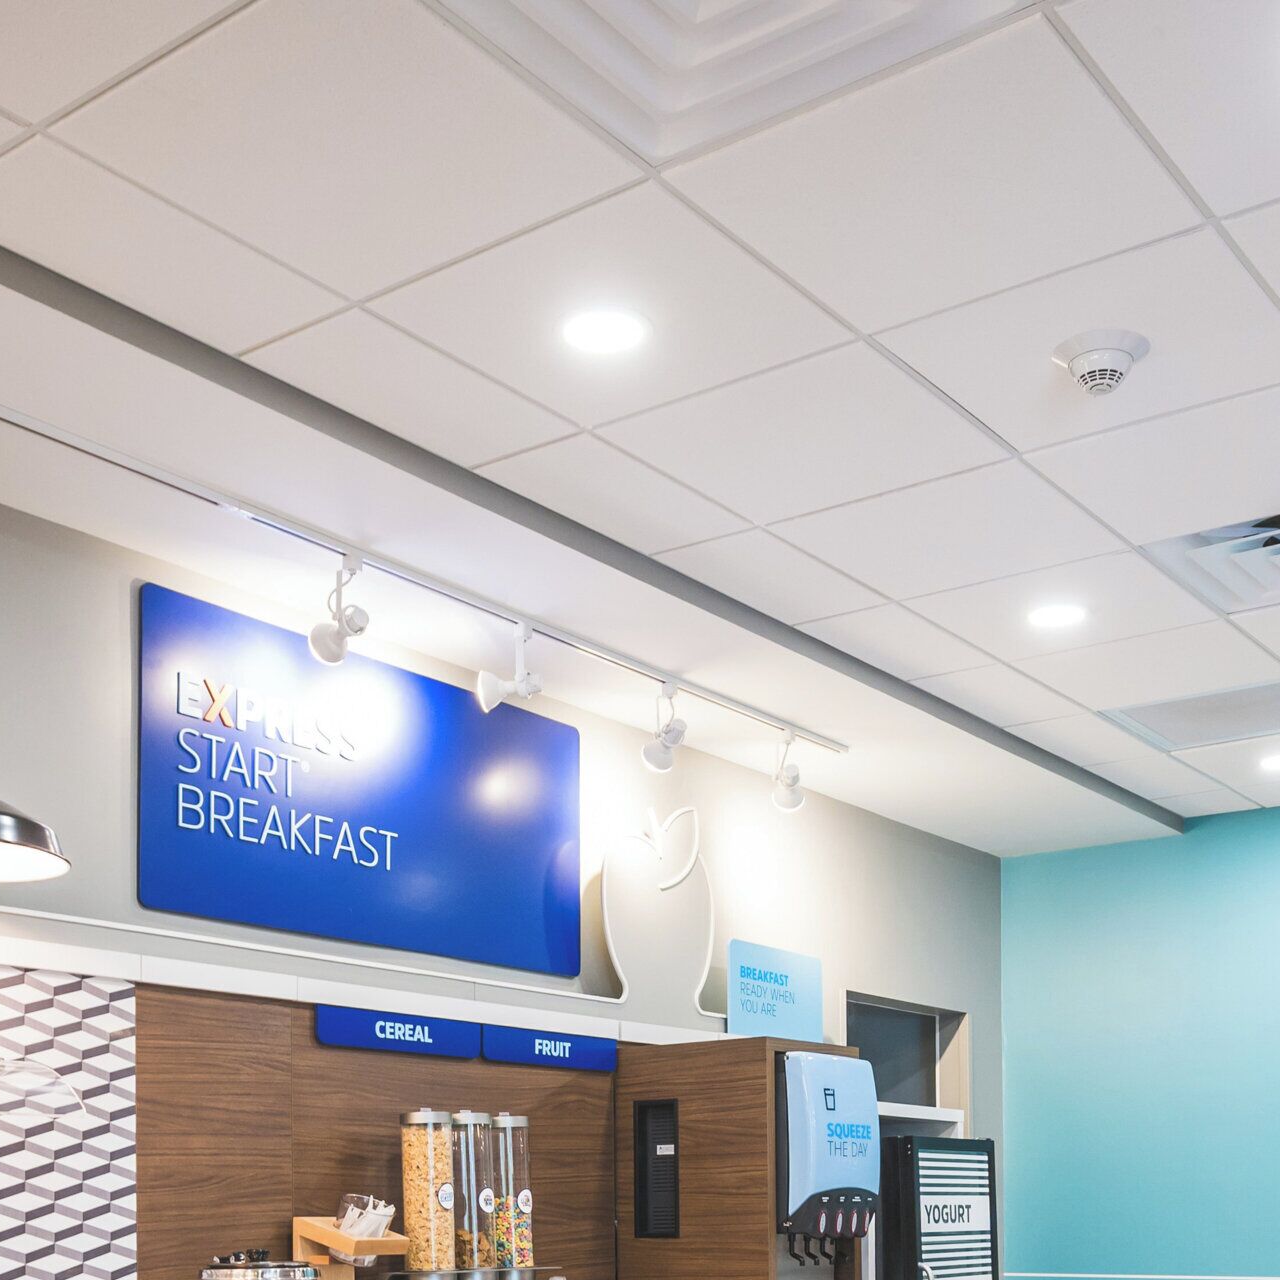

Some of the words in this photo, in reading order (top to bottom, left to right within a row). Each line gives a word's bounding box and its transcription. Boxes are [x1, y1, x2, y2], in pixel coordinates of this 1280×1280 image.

[177, 782, 399, 871] BREAKFAST
[740, 965, 789, 987] BREAKFAST
[740, 981, 768, 999] READY
[771, 988, 795, 1005] WHEN
[740, 998, 758, 1014] YOU
[761, 1002, 777, 1017] ARE
[375, 1020, 433, 1044] CEREAL
[534, 1038, 571, 1058] FRUIT
[827, 1122, 872, 1140] SQUEEZE
[827, 1140, 849, 1158] THE
[851, 1141, 869, 1158] DAY
[924, 1203, 972, 1225] YOGURT
